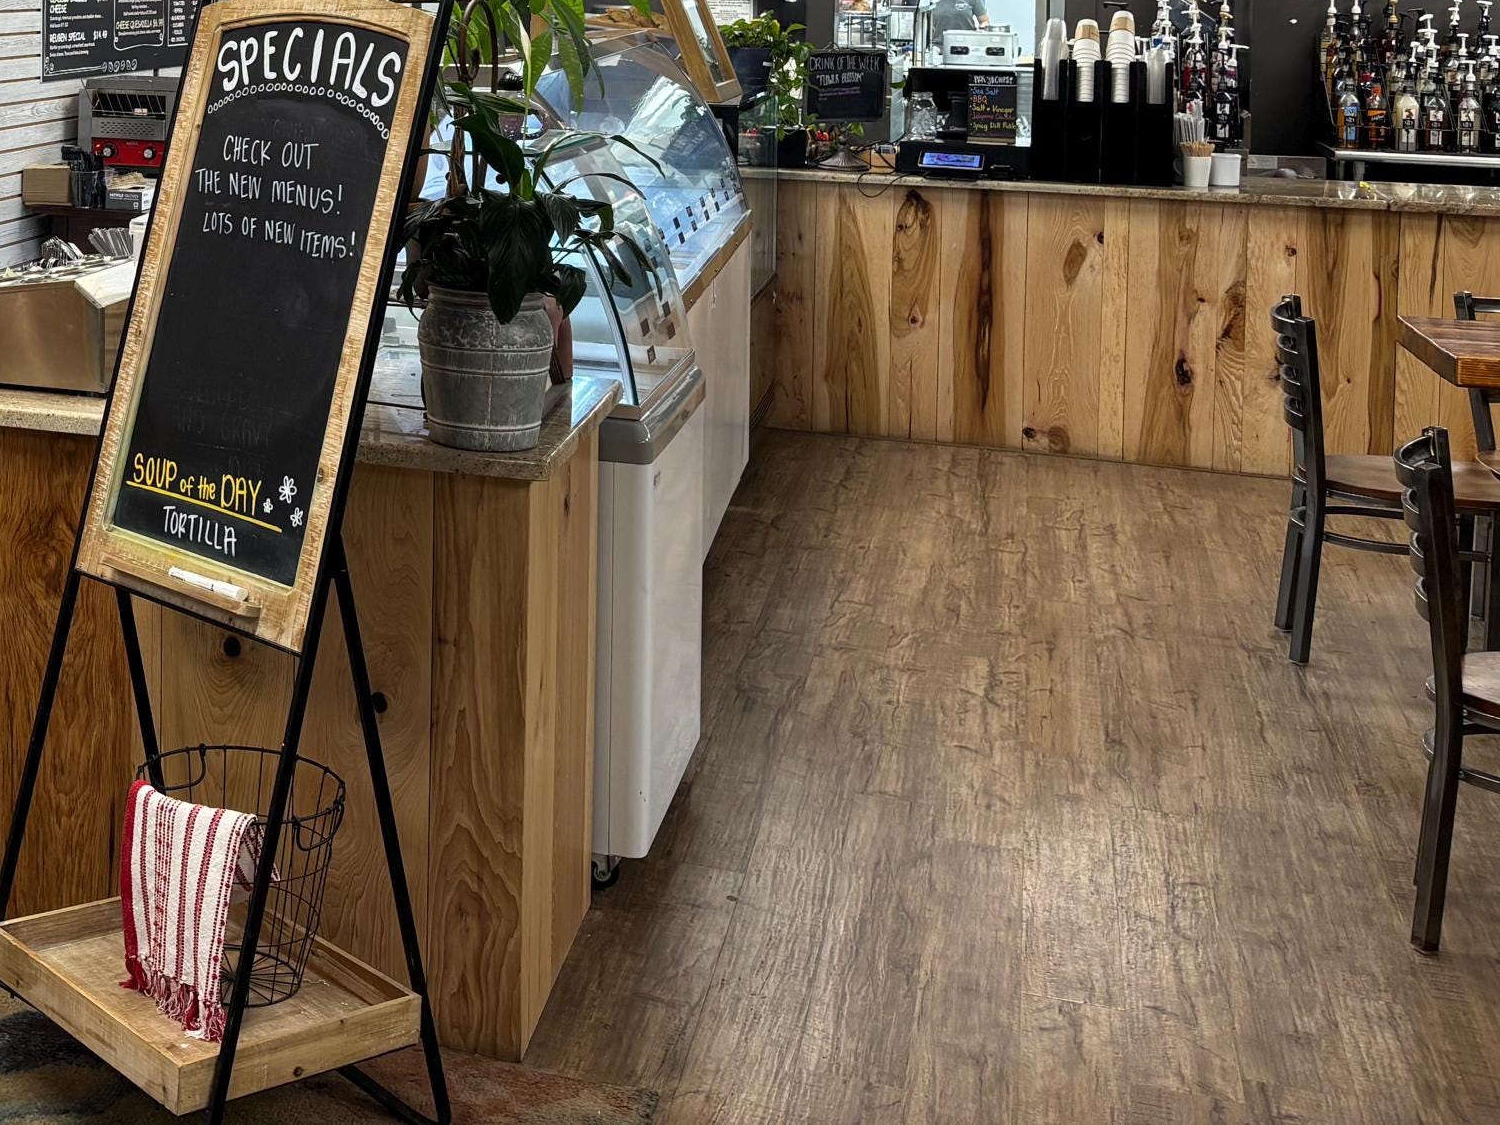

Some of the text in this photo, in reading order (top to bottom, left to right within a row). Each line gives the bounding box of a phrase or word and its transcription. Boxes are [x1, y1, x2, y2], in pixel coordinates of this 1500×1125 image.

[217, 27, 401, 107] SPECIALS
[809, 56, 835, 71] DRINK
[223, 135, 319, 170] CHECK OUT
[195, 168, 343, 216] THE NEW MENUS!
[202, 211, 355, 259] LOTS OF NEW ITEMS!
[133, 452, 262, 516] SOUP of the DAY
[163, 505, 238, 557] TORTILLA
